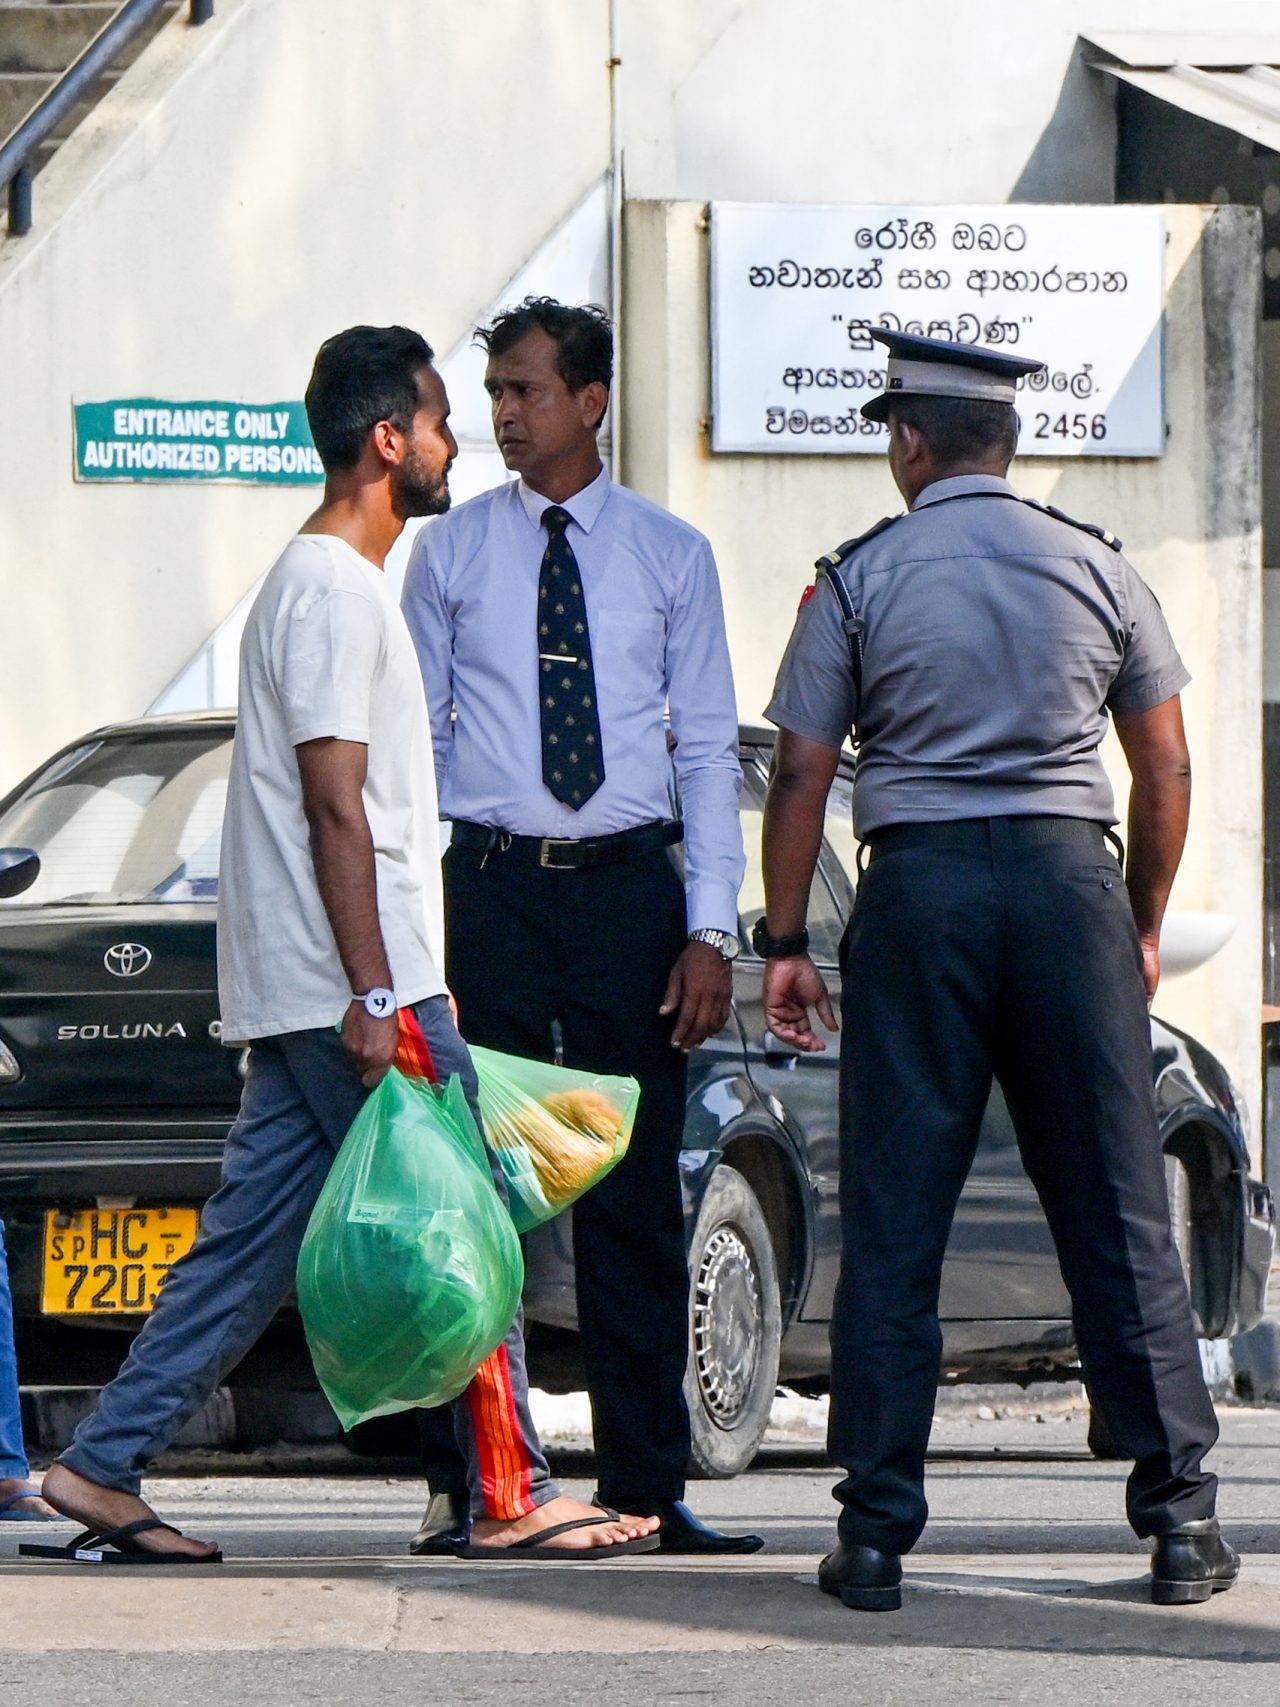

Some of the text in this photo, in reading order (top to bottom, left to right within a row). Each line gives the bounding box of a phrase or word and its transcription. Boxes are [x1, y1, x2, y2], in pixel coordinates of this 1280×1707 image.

[854, 218, 1027, 252] රෝගී ඔබට
[748, 257, 1129, 298] නවාතැන් සහ ආහාරපාන
[113, 408, 290, 440] ENTRANCE ONLY
[1034, 412, 1107, 440] 2456
[83, 440, 325, 475] AUTHORIZED PERSONS
[57, 1022, 187, 1041] SOLUNA
